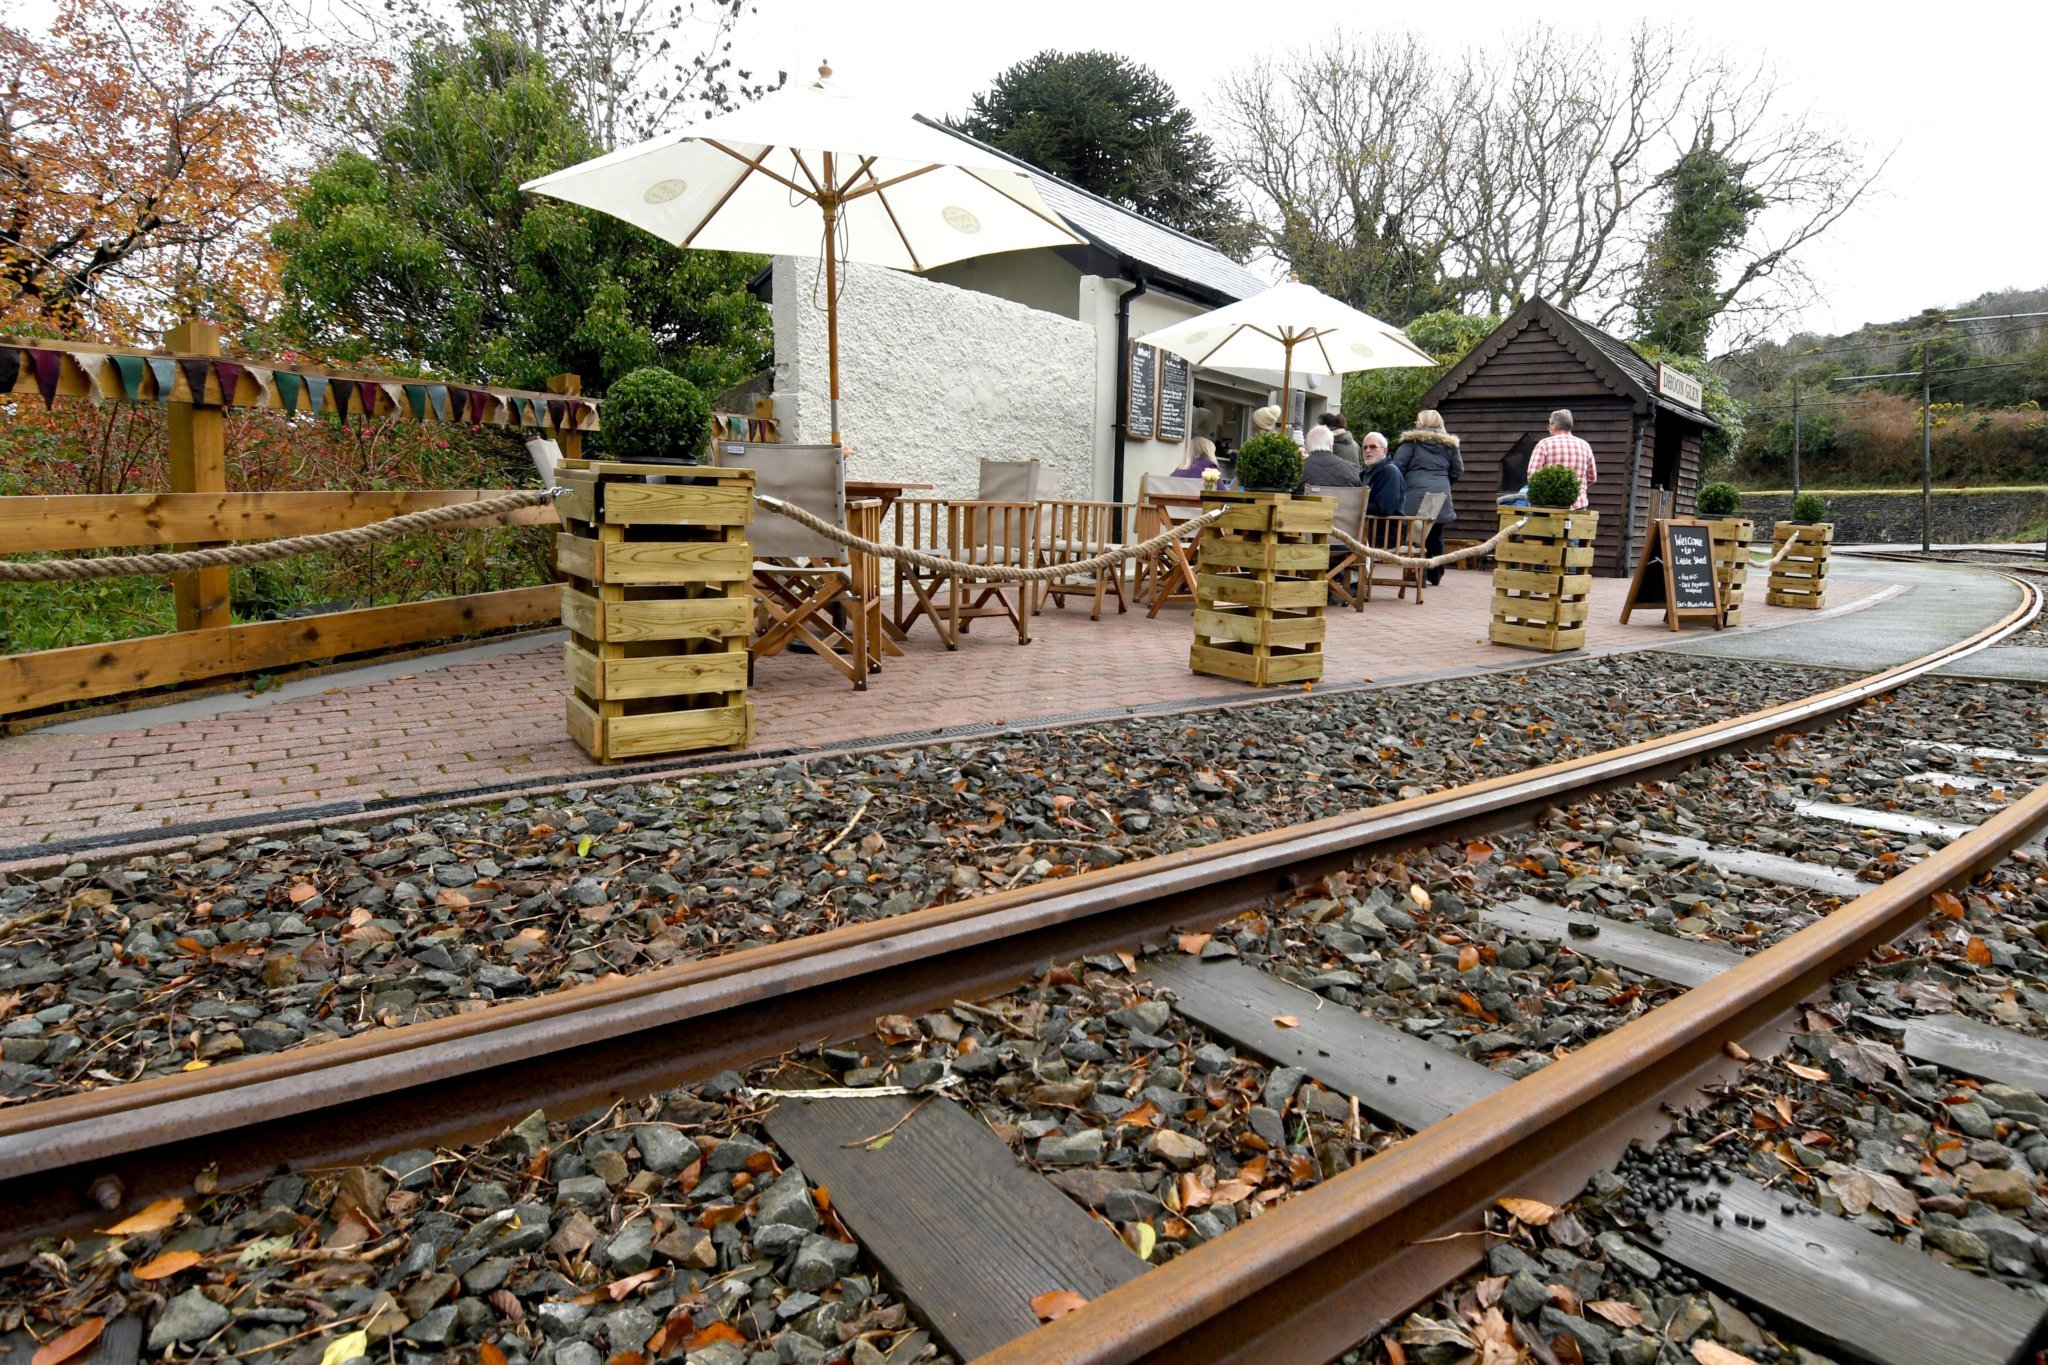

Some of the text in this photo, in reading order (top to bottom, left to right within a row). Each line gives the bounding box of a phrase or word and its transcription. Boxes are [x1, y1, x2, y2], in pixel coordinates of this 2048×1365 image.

[1664, 372, 1699, 402] DHOON GLEN
[1675, 555, 1707, 565] Little Shed
